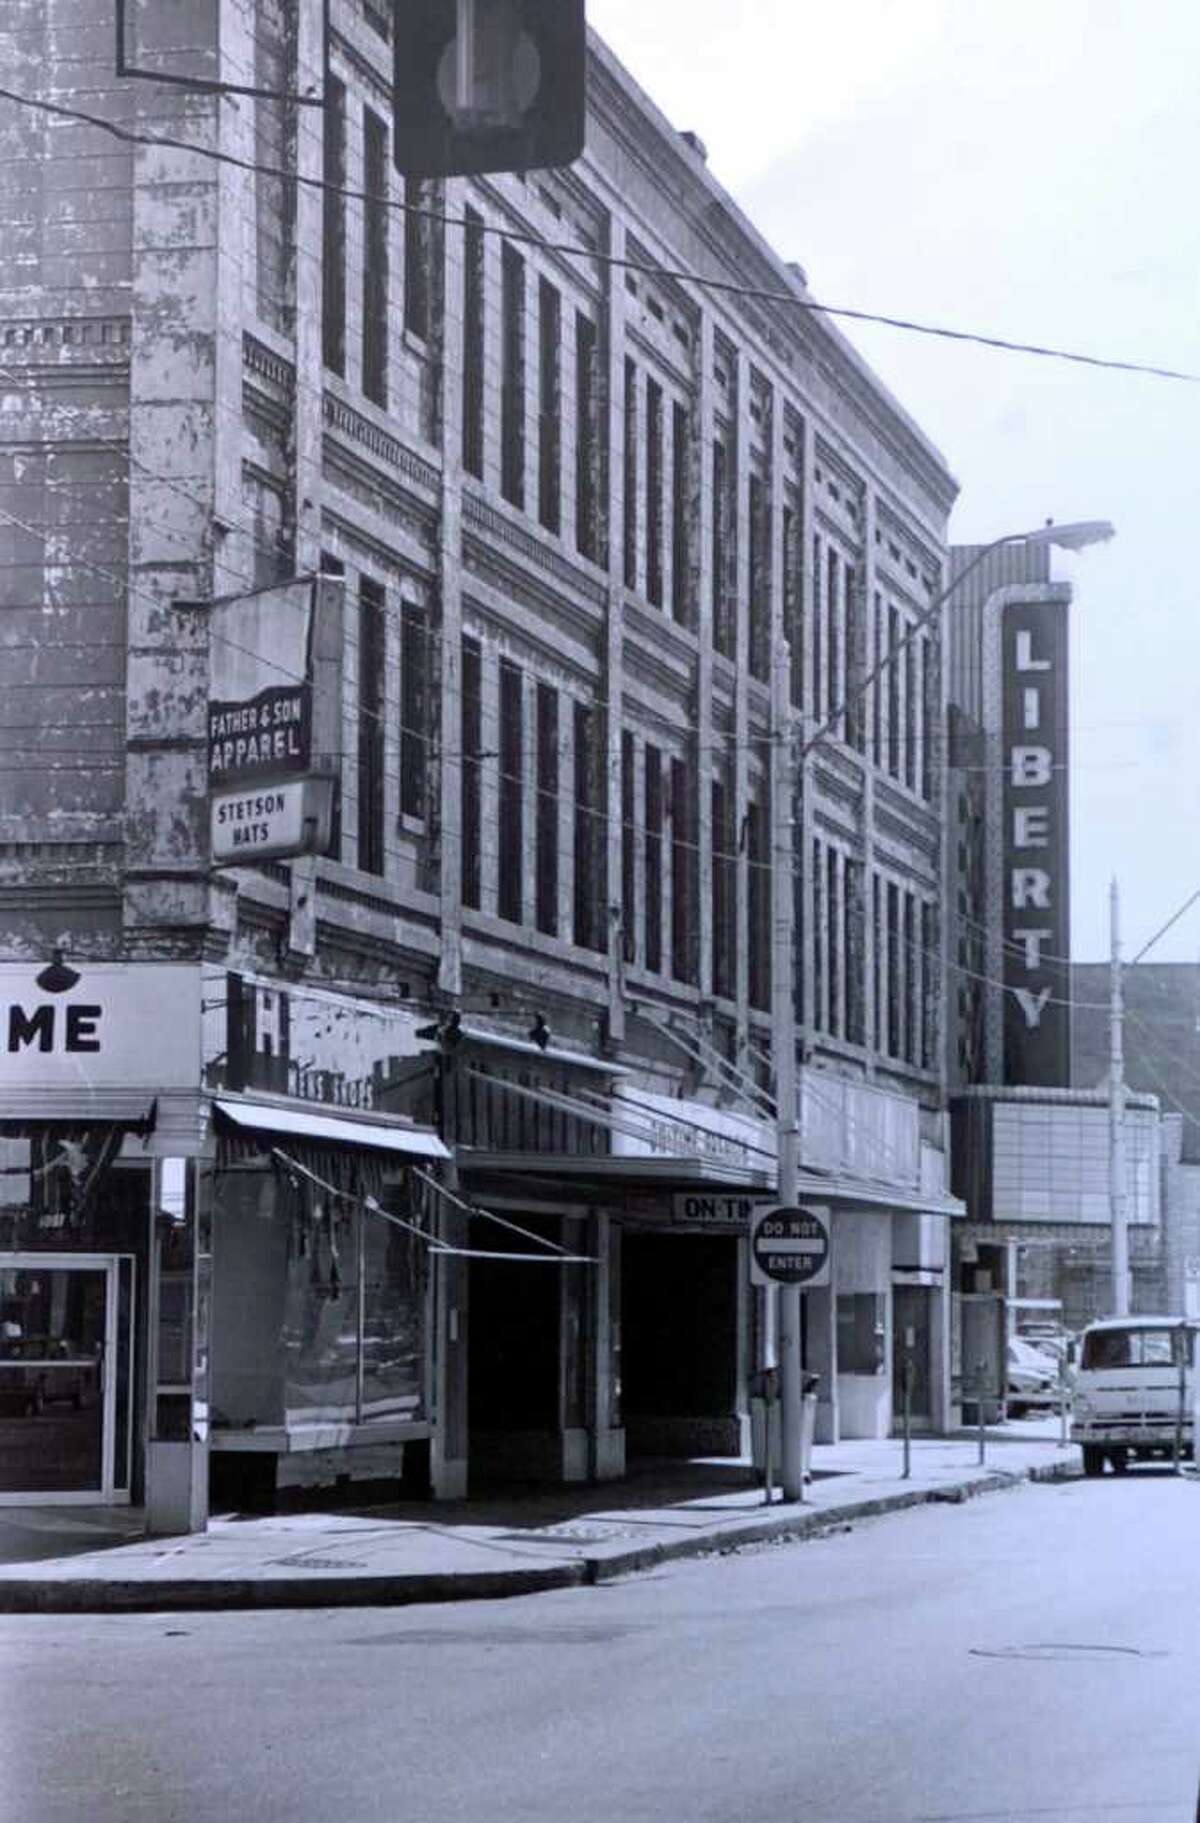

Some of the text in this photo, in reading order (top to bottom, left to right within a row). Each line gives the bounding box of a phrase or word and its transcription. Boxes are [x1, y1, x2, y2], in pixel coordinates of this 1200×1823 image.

[211, 697, 302, 738] FATHER & SON
[210, 728, 301, 772] APPAREL
[218, 794, 285, 823] STETSON
[232, 823, 269, 845] HATS
[1011, 630, 1053, 1029] LIBERTY
[7, 1004, 103, 1052] ME
[763, 1221, 818, 1235] DO NOT
[768, 1255, 813, 1270] ENTER
